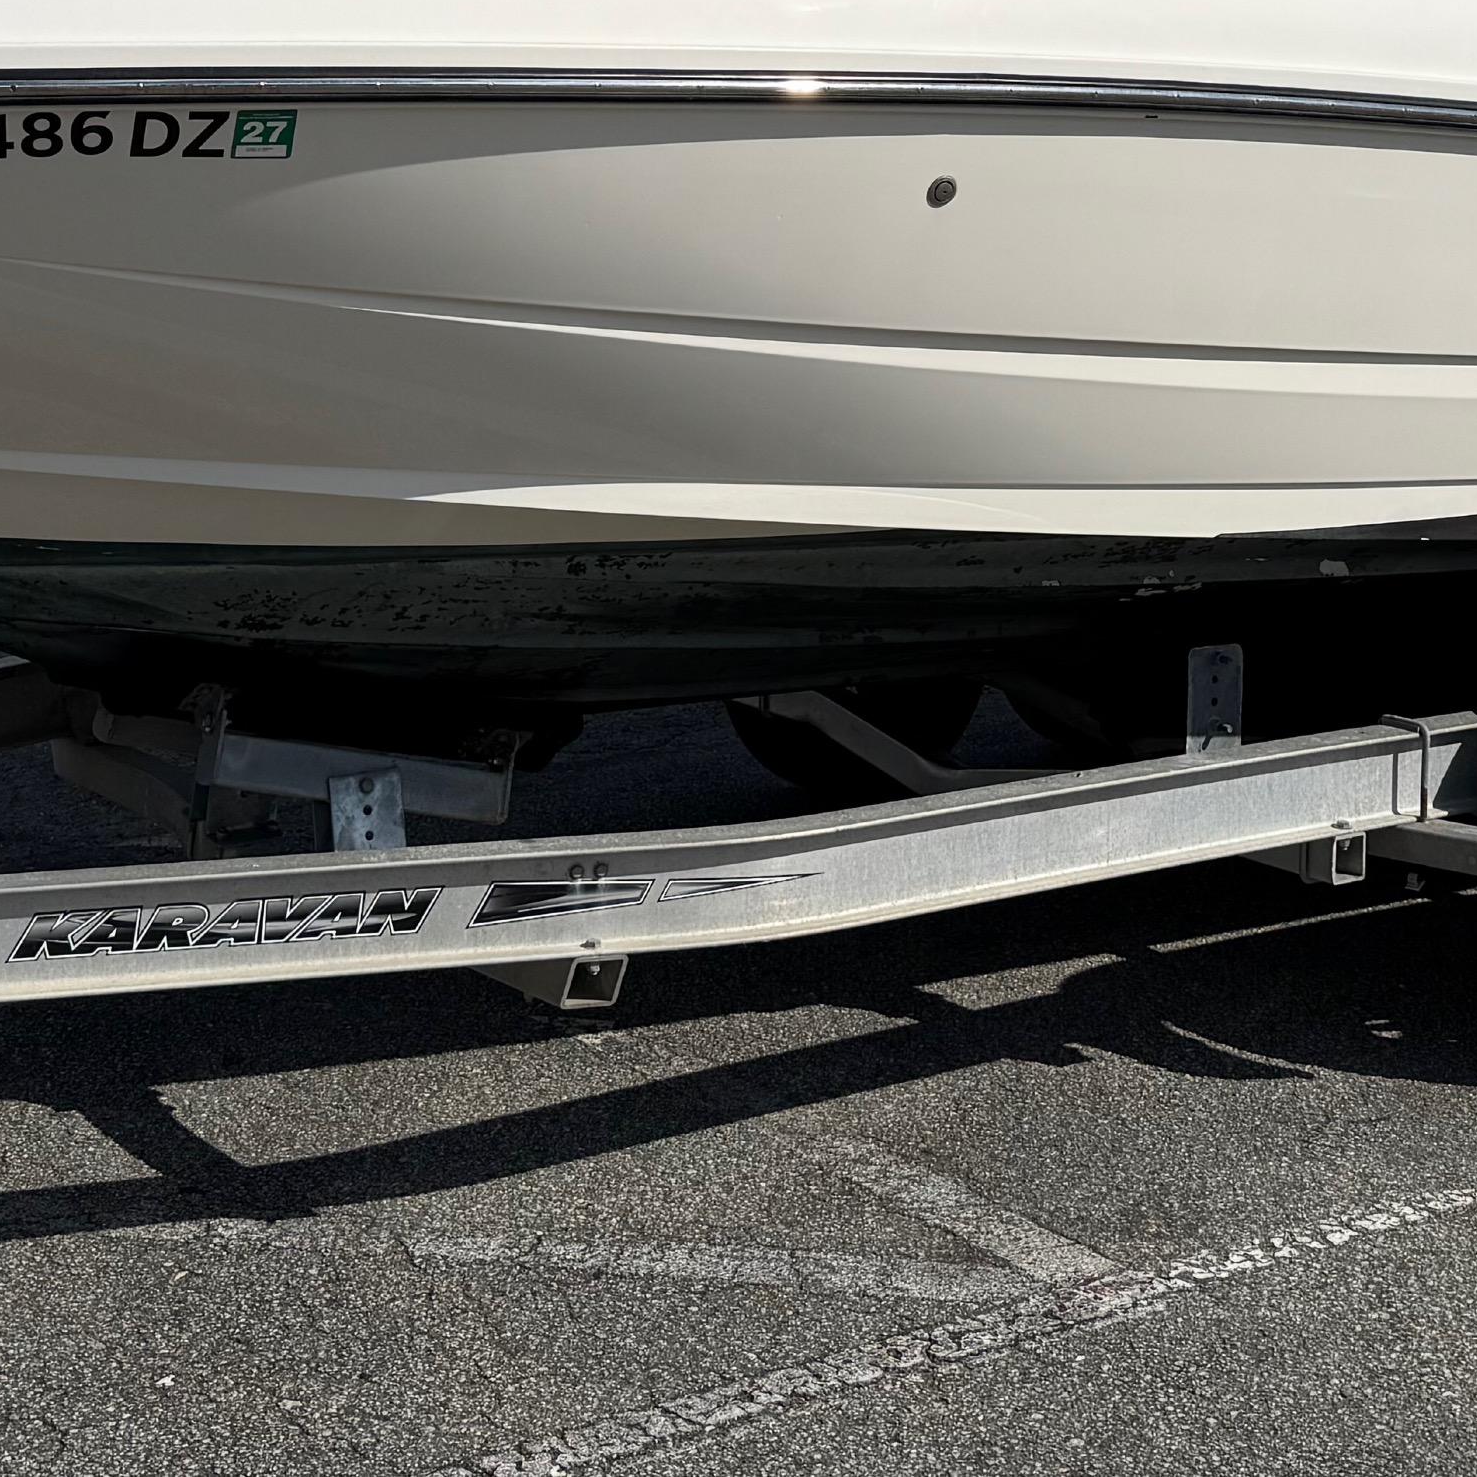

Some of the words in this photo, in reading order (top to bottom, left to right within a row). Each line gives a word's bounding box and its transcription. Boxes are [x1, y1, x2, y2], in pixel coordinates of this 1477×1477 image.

[129, 110, 232, 159] DZ
[240, 121, 288, 143] 27
[6, 886, 442, 964] KARAVAN
